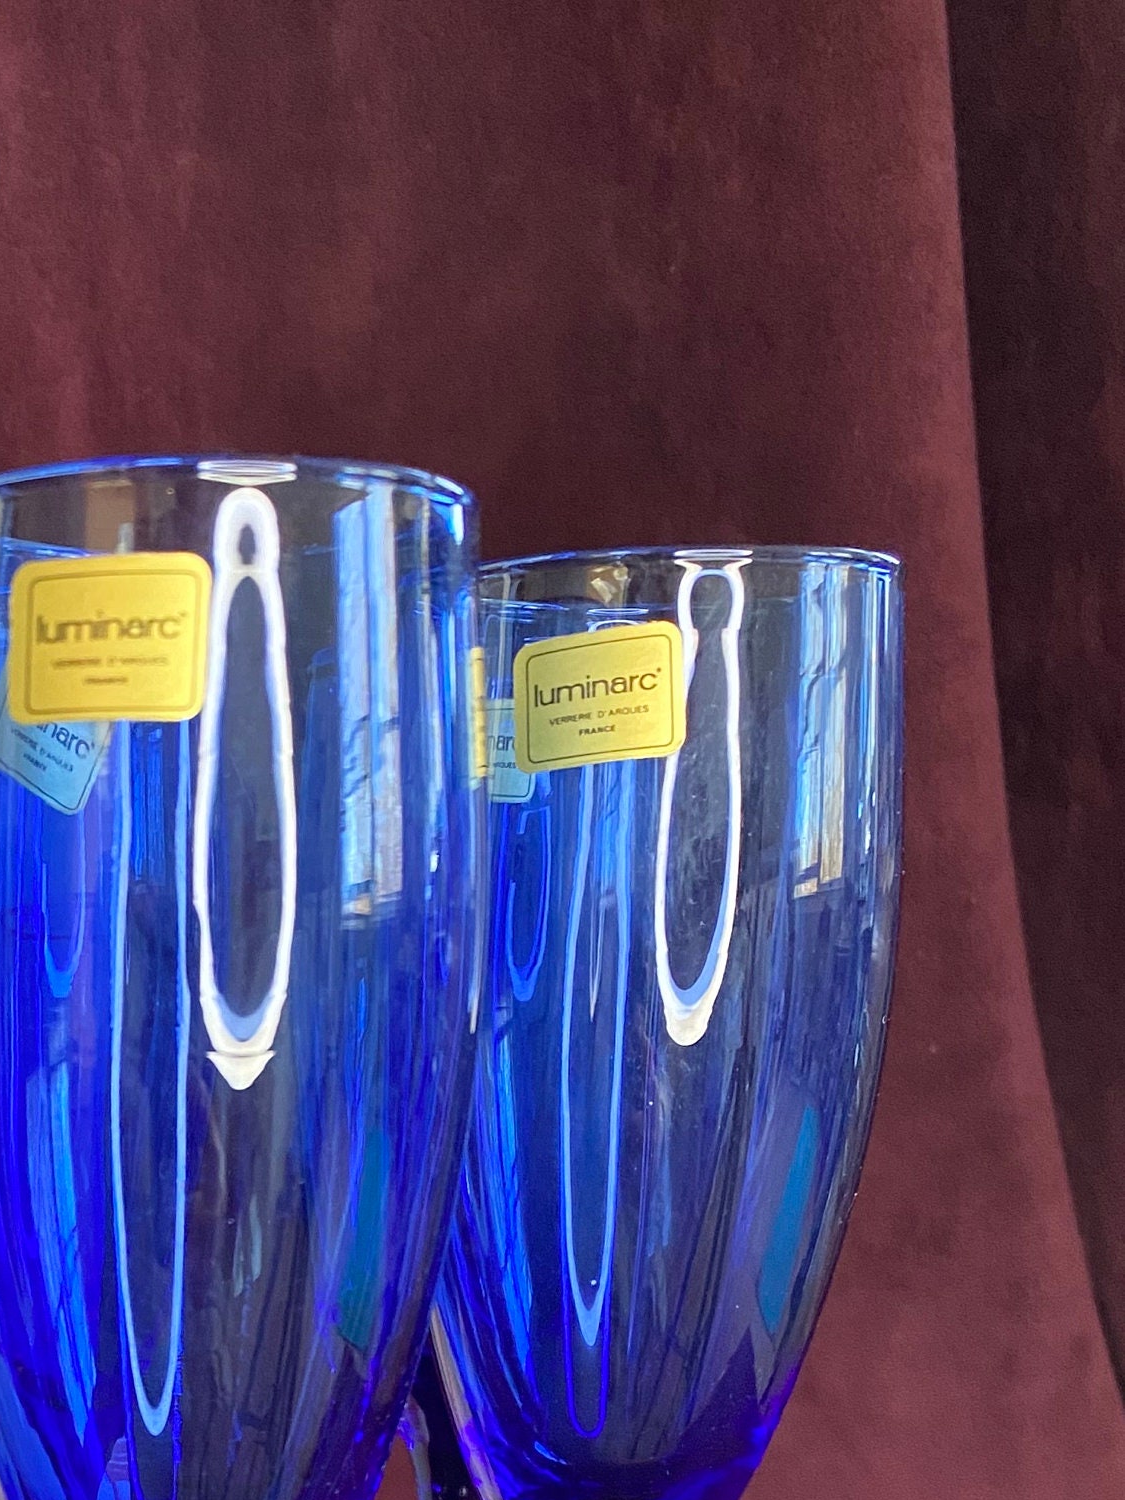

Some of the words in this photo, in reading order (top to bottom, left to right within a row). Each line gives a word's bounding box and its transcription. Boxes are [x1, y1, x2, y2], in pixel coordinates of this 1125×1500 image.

[36, 609, 181, 643] luminarc
[534, 672, 658, 707] luminarc
[578, 724, 616, 736] FRANCE
